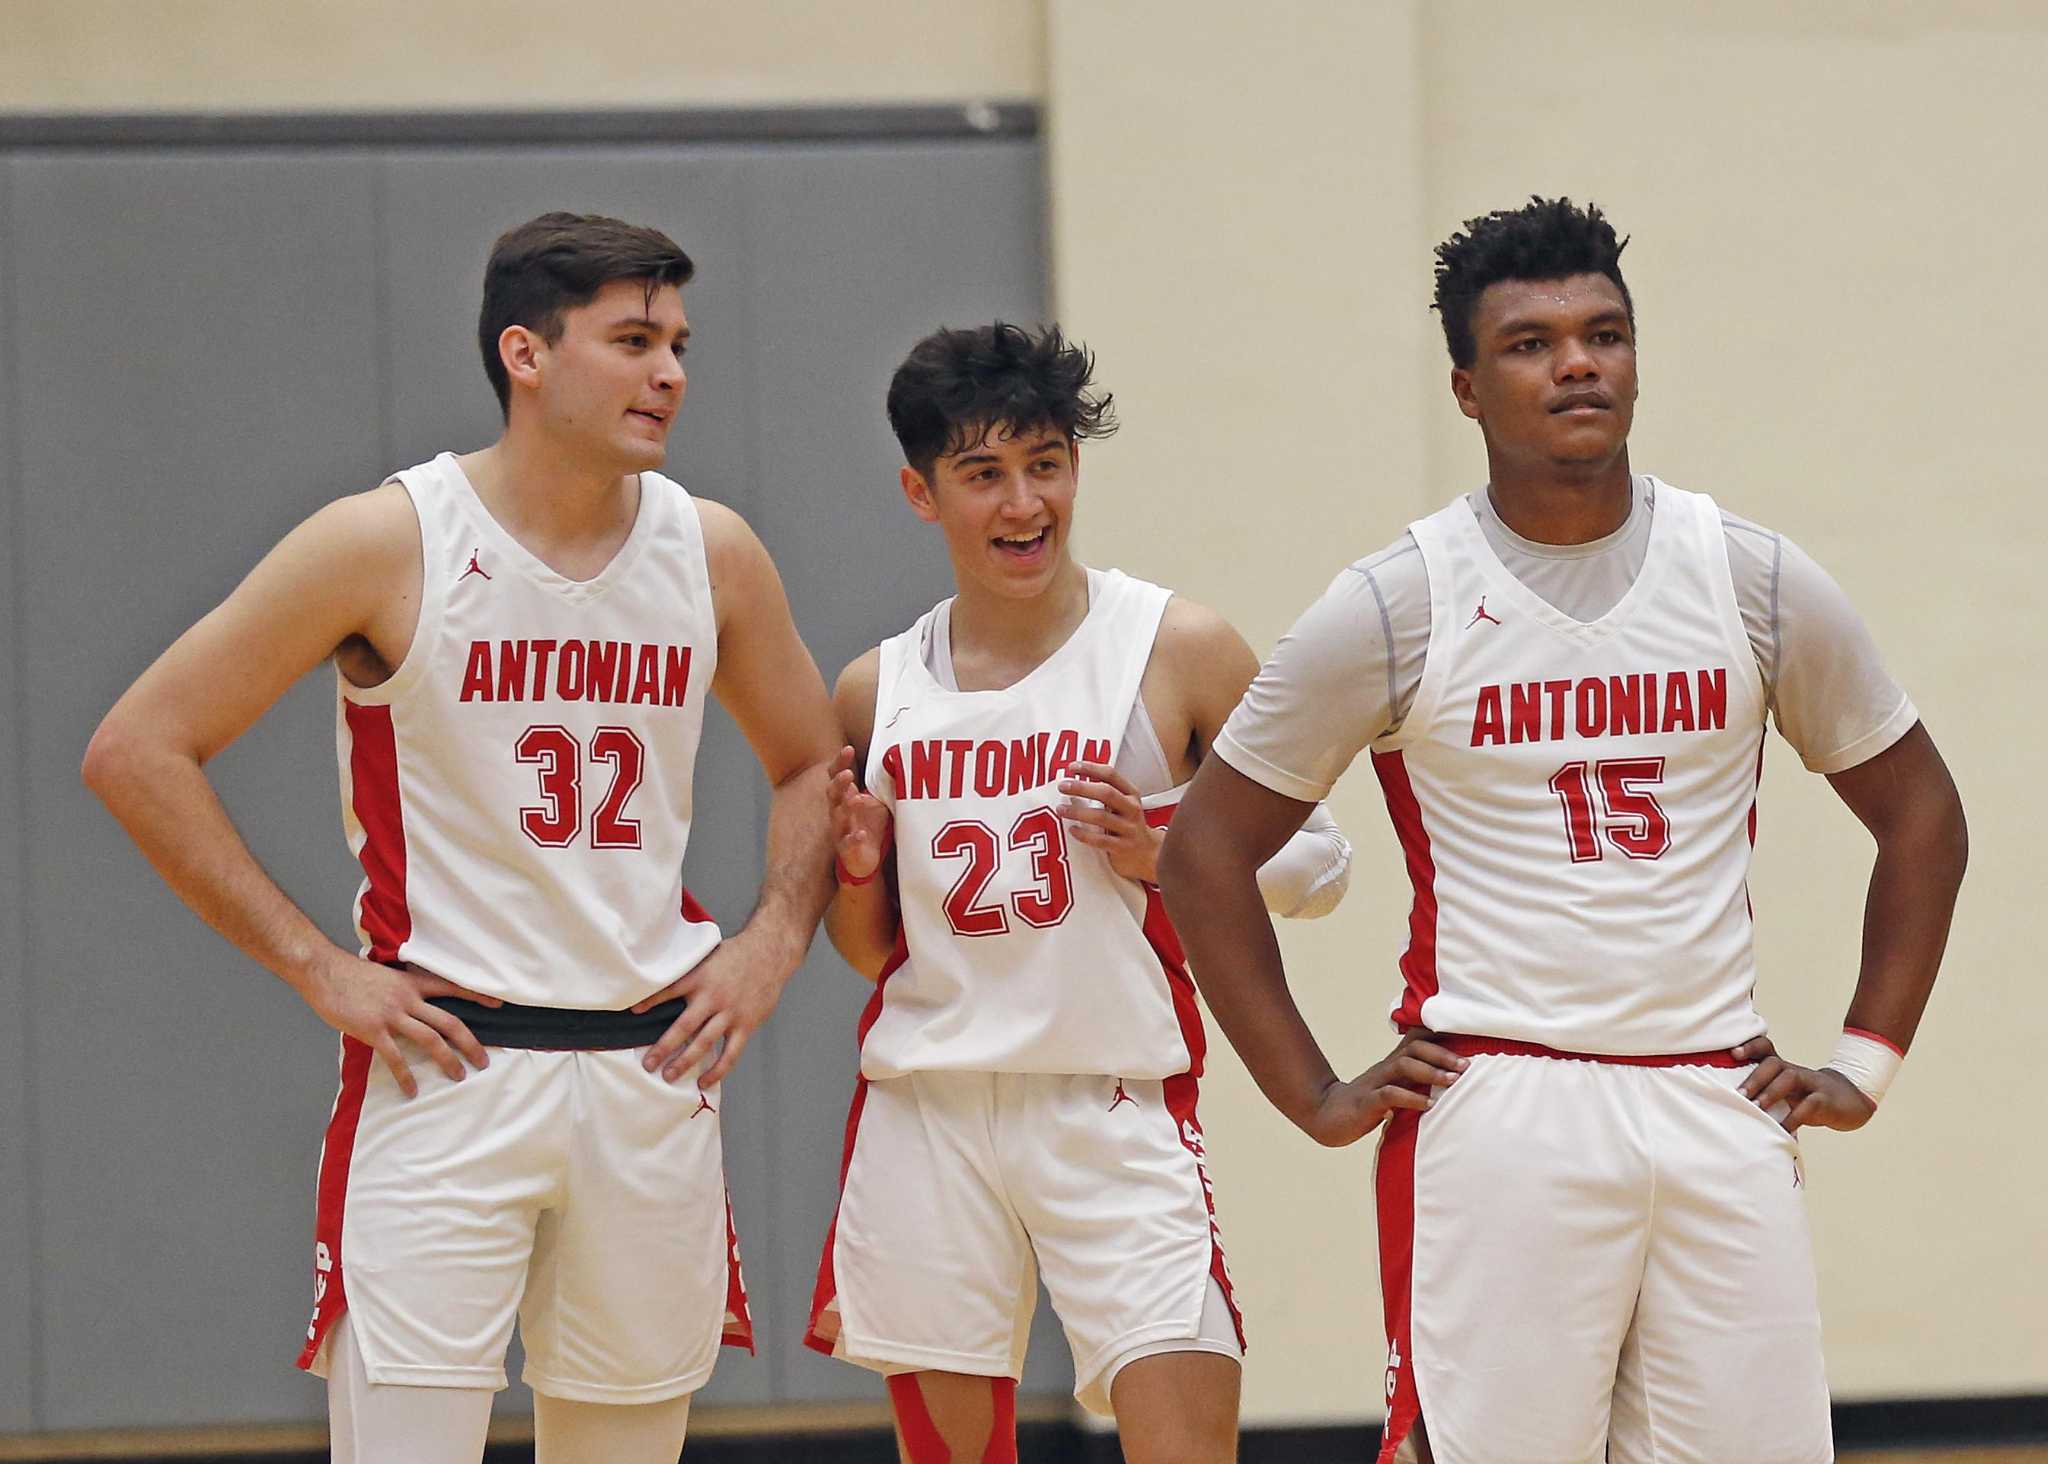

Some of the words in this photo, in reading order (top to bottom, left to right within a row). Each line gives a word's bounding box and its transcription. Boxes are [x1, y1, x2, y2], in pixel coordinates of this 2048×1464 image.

[459, 639, 692, 707] ANTONIAN
[1470, 668, 1727, 747] ANTONIAN
[514, 725, 645, 850] 32
[1548, 756, 1672, 863] 15
[931, 805, 1074, 937] 23
